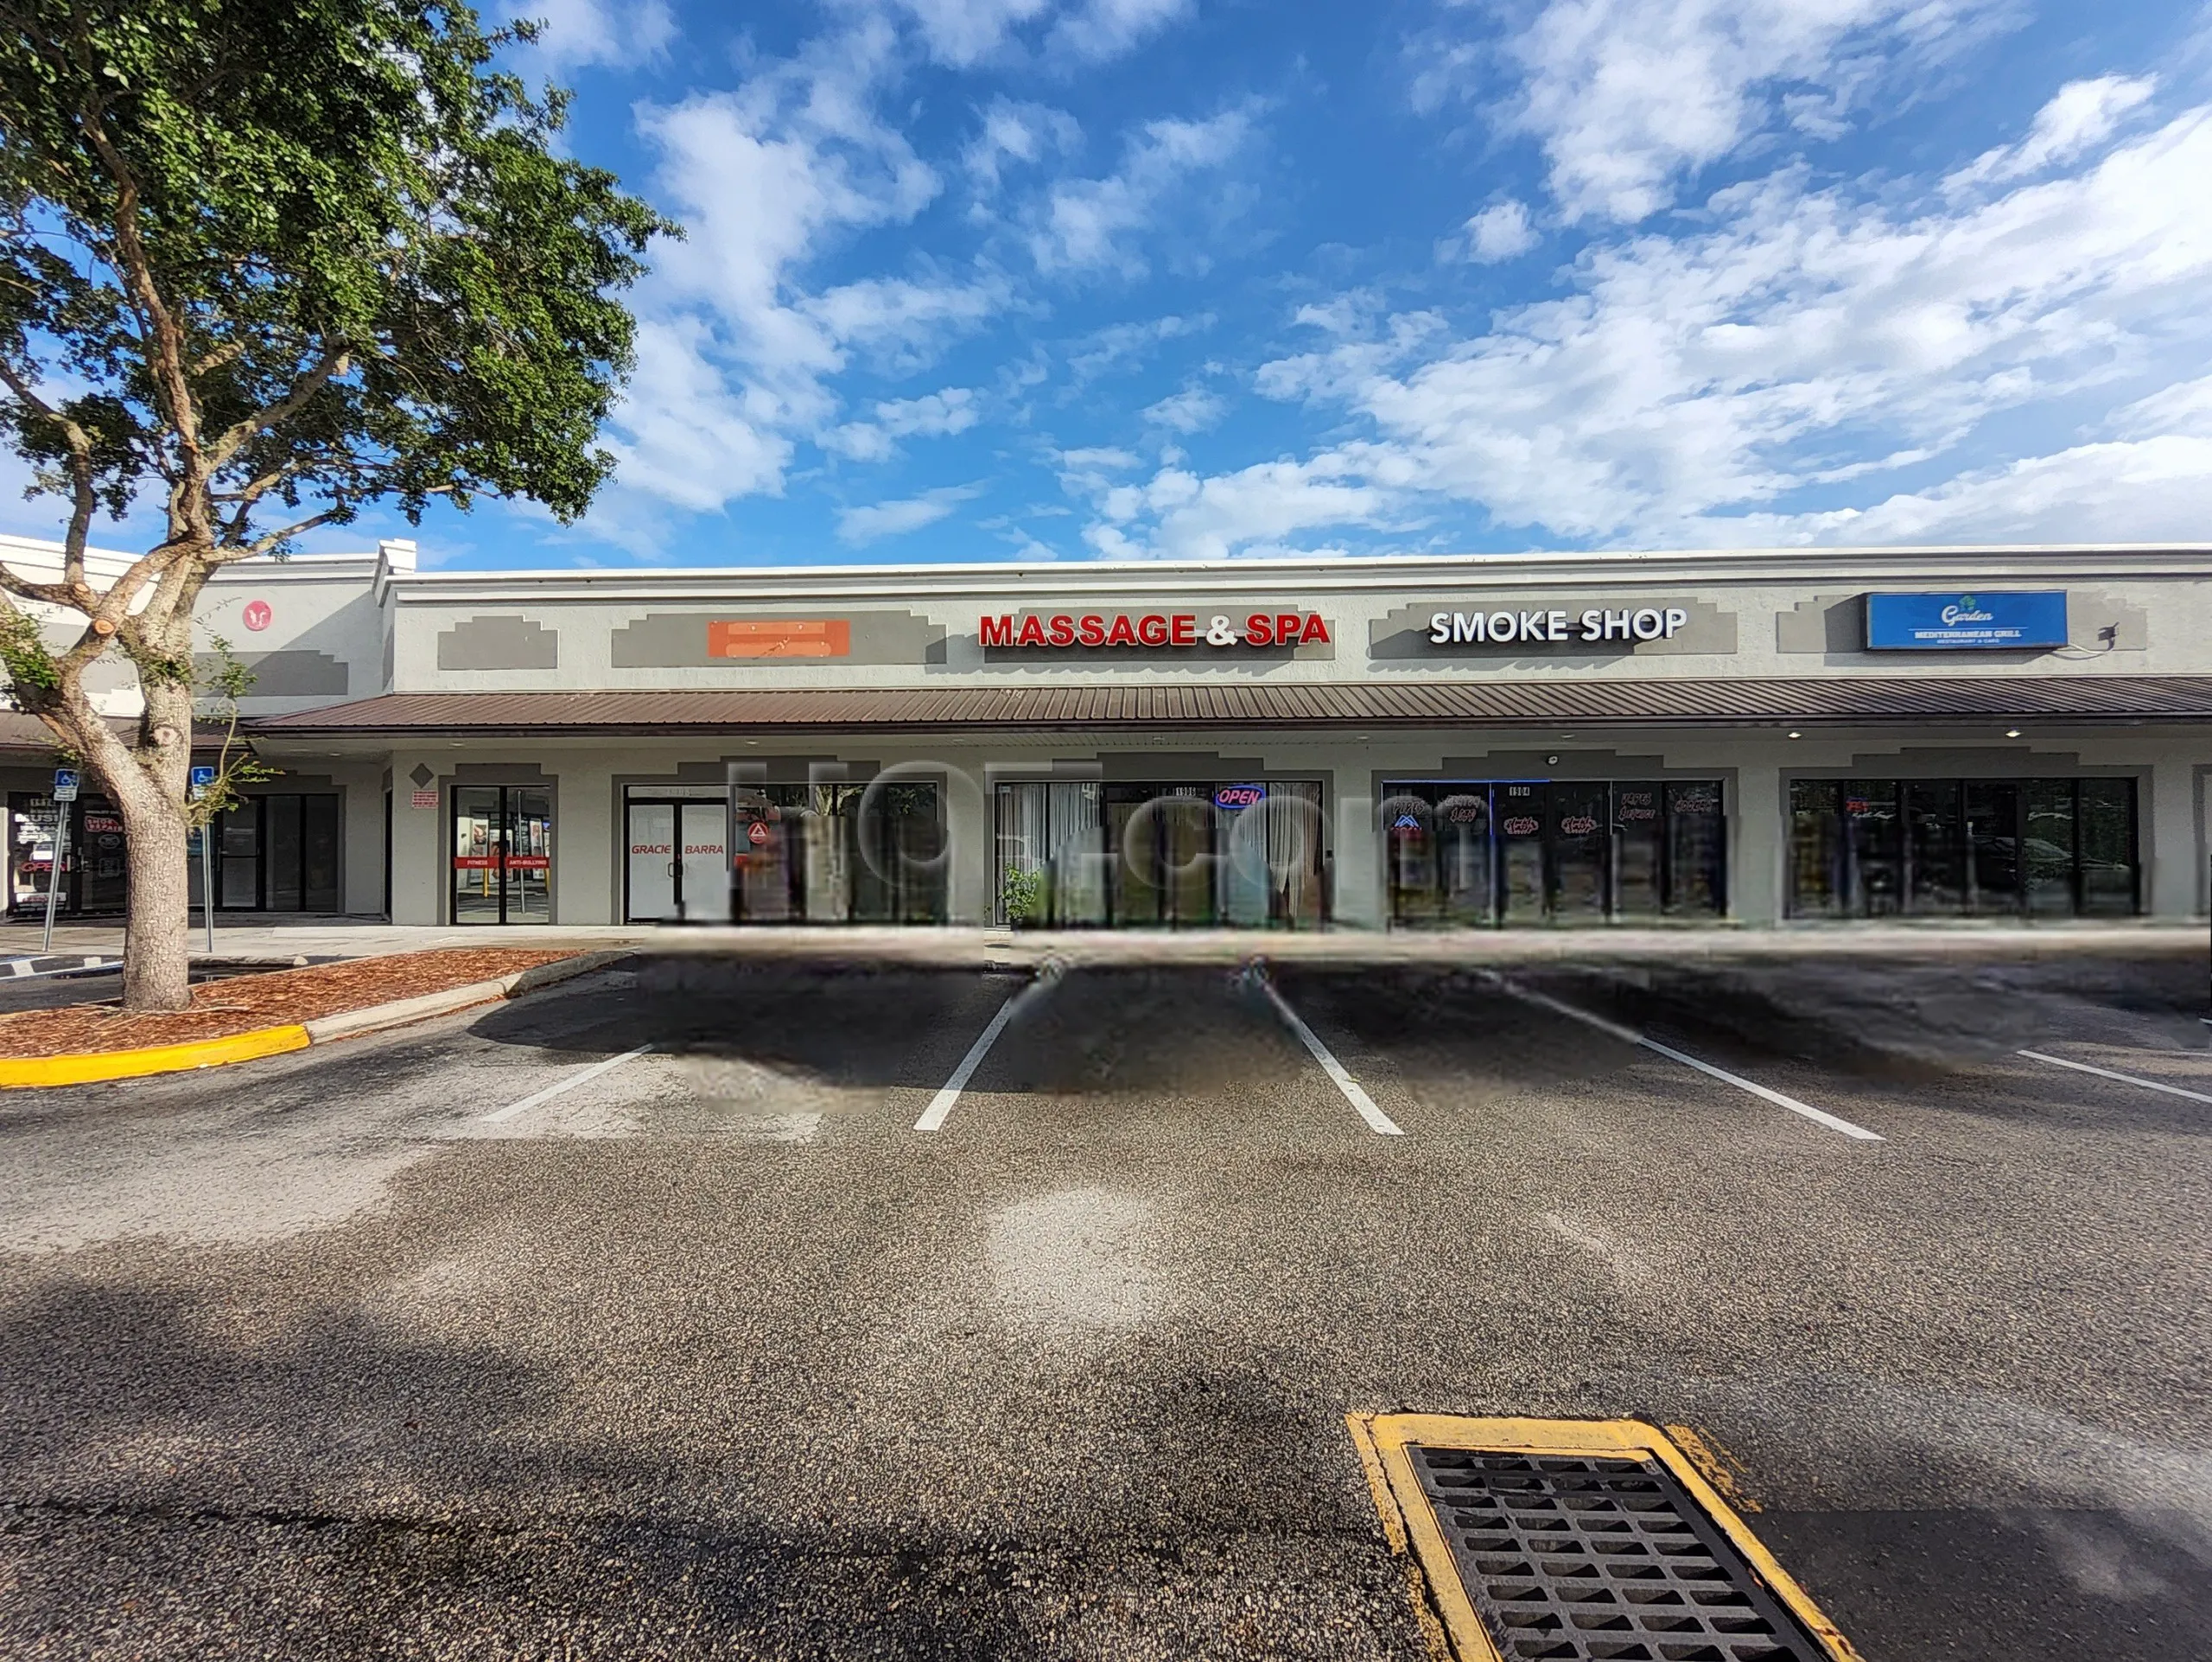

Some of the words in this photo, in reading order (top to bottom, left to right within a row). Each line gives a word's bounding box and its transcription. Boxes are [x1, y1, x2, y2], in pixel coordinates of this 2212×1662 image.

[1941, 605, 1993, 627] Garden
[978, 614, 1197, 648] MASSAGE
[1205, 615, 1238, 646] &
[1245, 614, 1331, 646] SPA
[1429, 611, 1569, 644] SMOKE
[1580, 608, 1688, 641] SHOP
[1219, 789, 1260, 805] OPEN
[632, 844, 671, 854] GRACIE
[685, 844, 724, 854] BARRA
